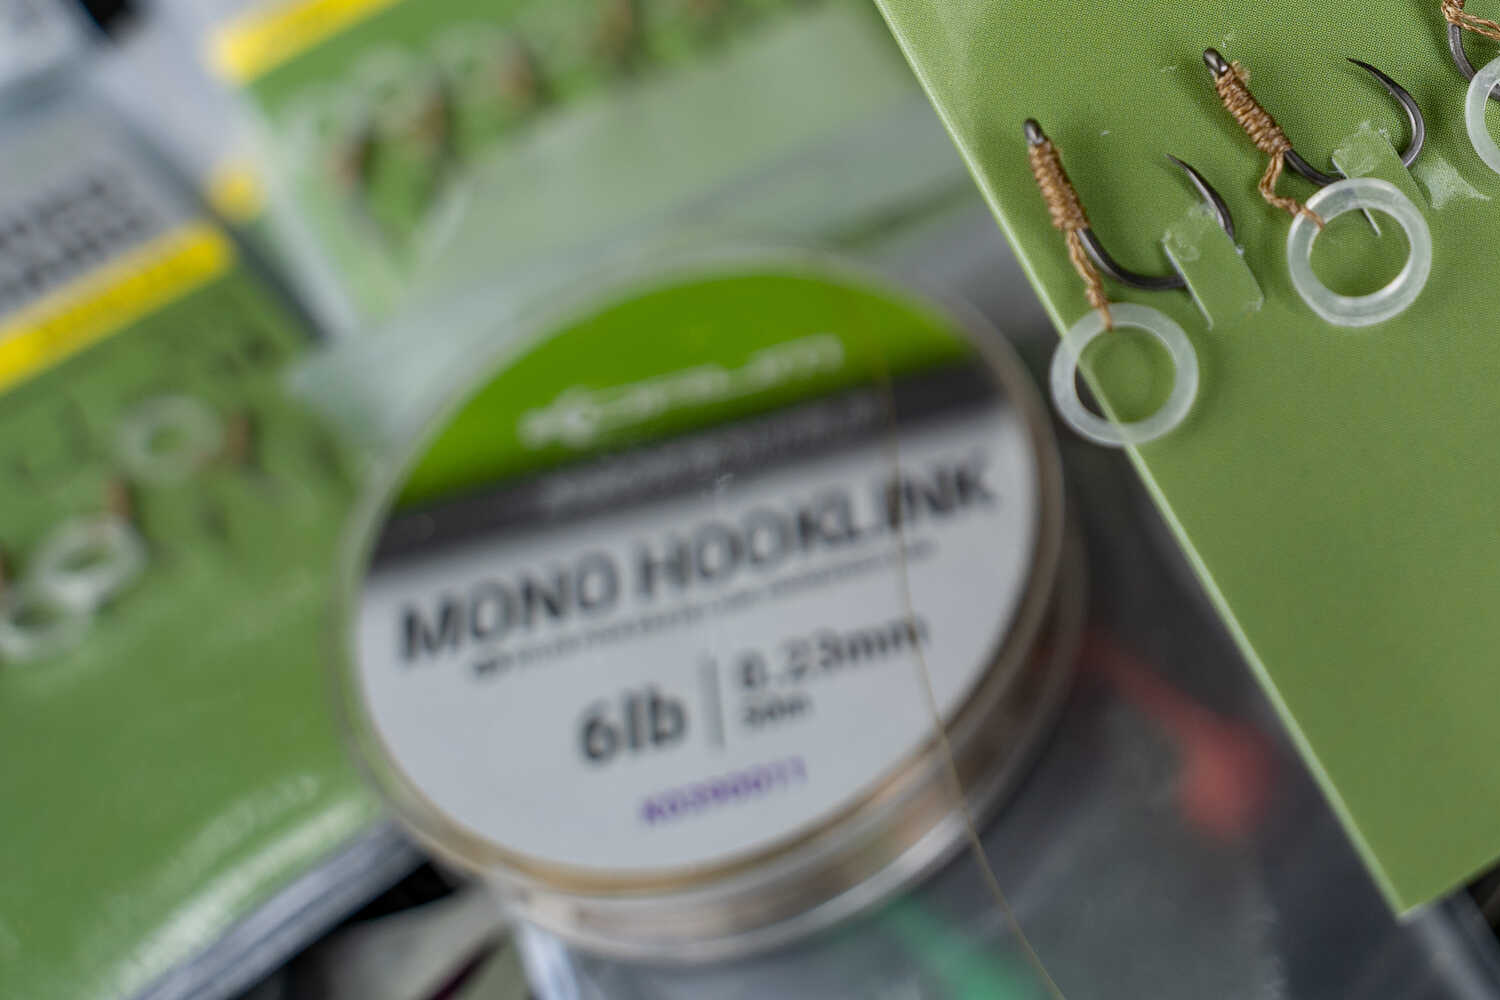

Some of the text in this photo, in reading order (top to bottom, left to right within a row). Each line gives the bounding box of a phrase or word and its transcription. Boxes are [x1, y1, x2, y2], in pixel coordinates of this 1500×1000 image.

[400, 555, 621, 665] MONO
[638, 458, 999, 597] HOOKLINK
[579, 686, 688, 766] 6lb
